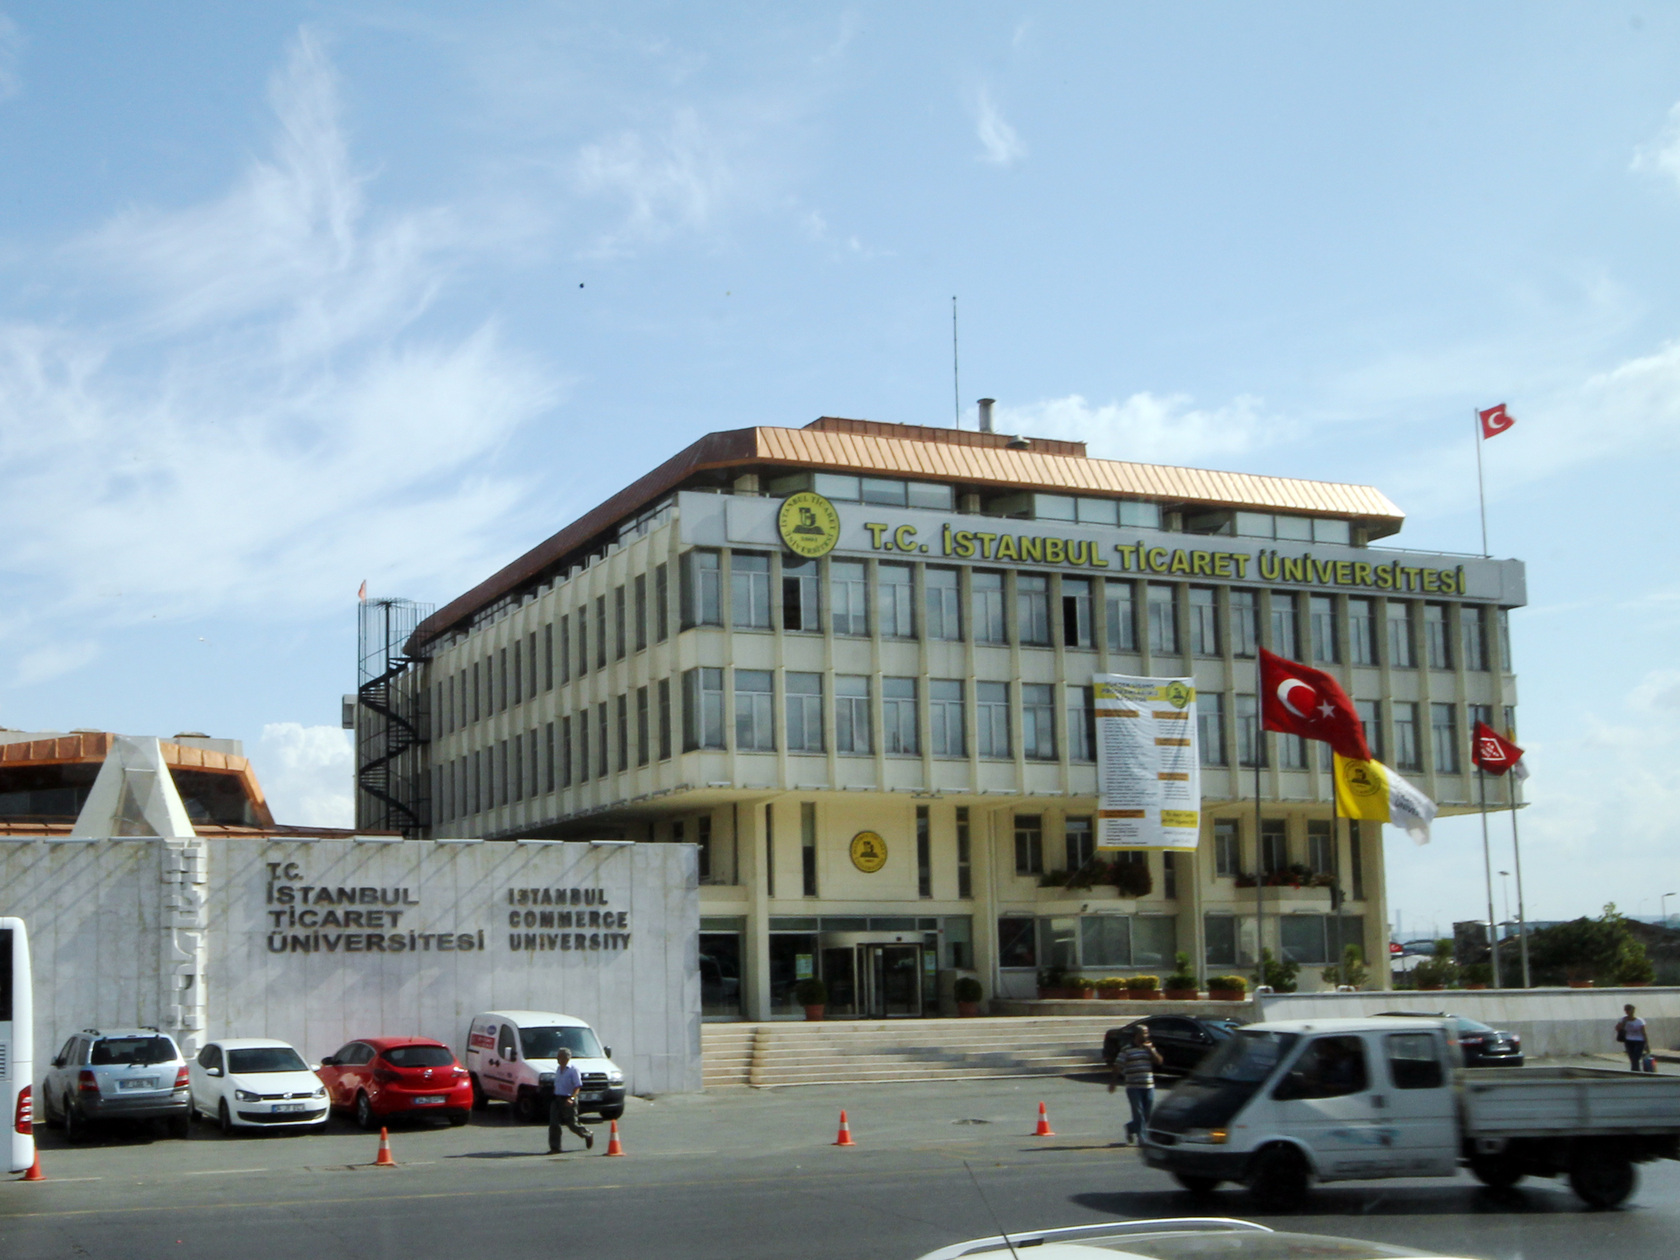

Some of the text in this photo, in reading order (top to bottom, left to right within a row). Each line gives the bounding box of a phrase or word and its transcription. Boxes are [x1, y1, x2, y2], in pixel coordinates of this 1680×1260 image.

[865, 522, 1467, 595] T.C. İSTANBUL TİCARET ÜNİVERSİTESİ
[266, 881, 420, 906] İSTANBUL
[267, 905, 404, 929] TİCARET
[508, 910, 629, 929] COMMERCE
[267, 929, 485, 954] ÜNİVERSİTESİ
[508, 932, 631, 952] UNIVERSITY
